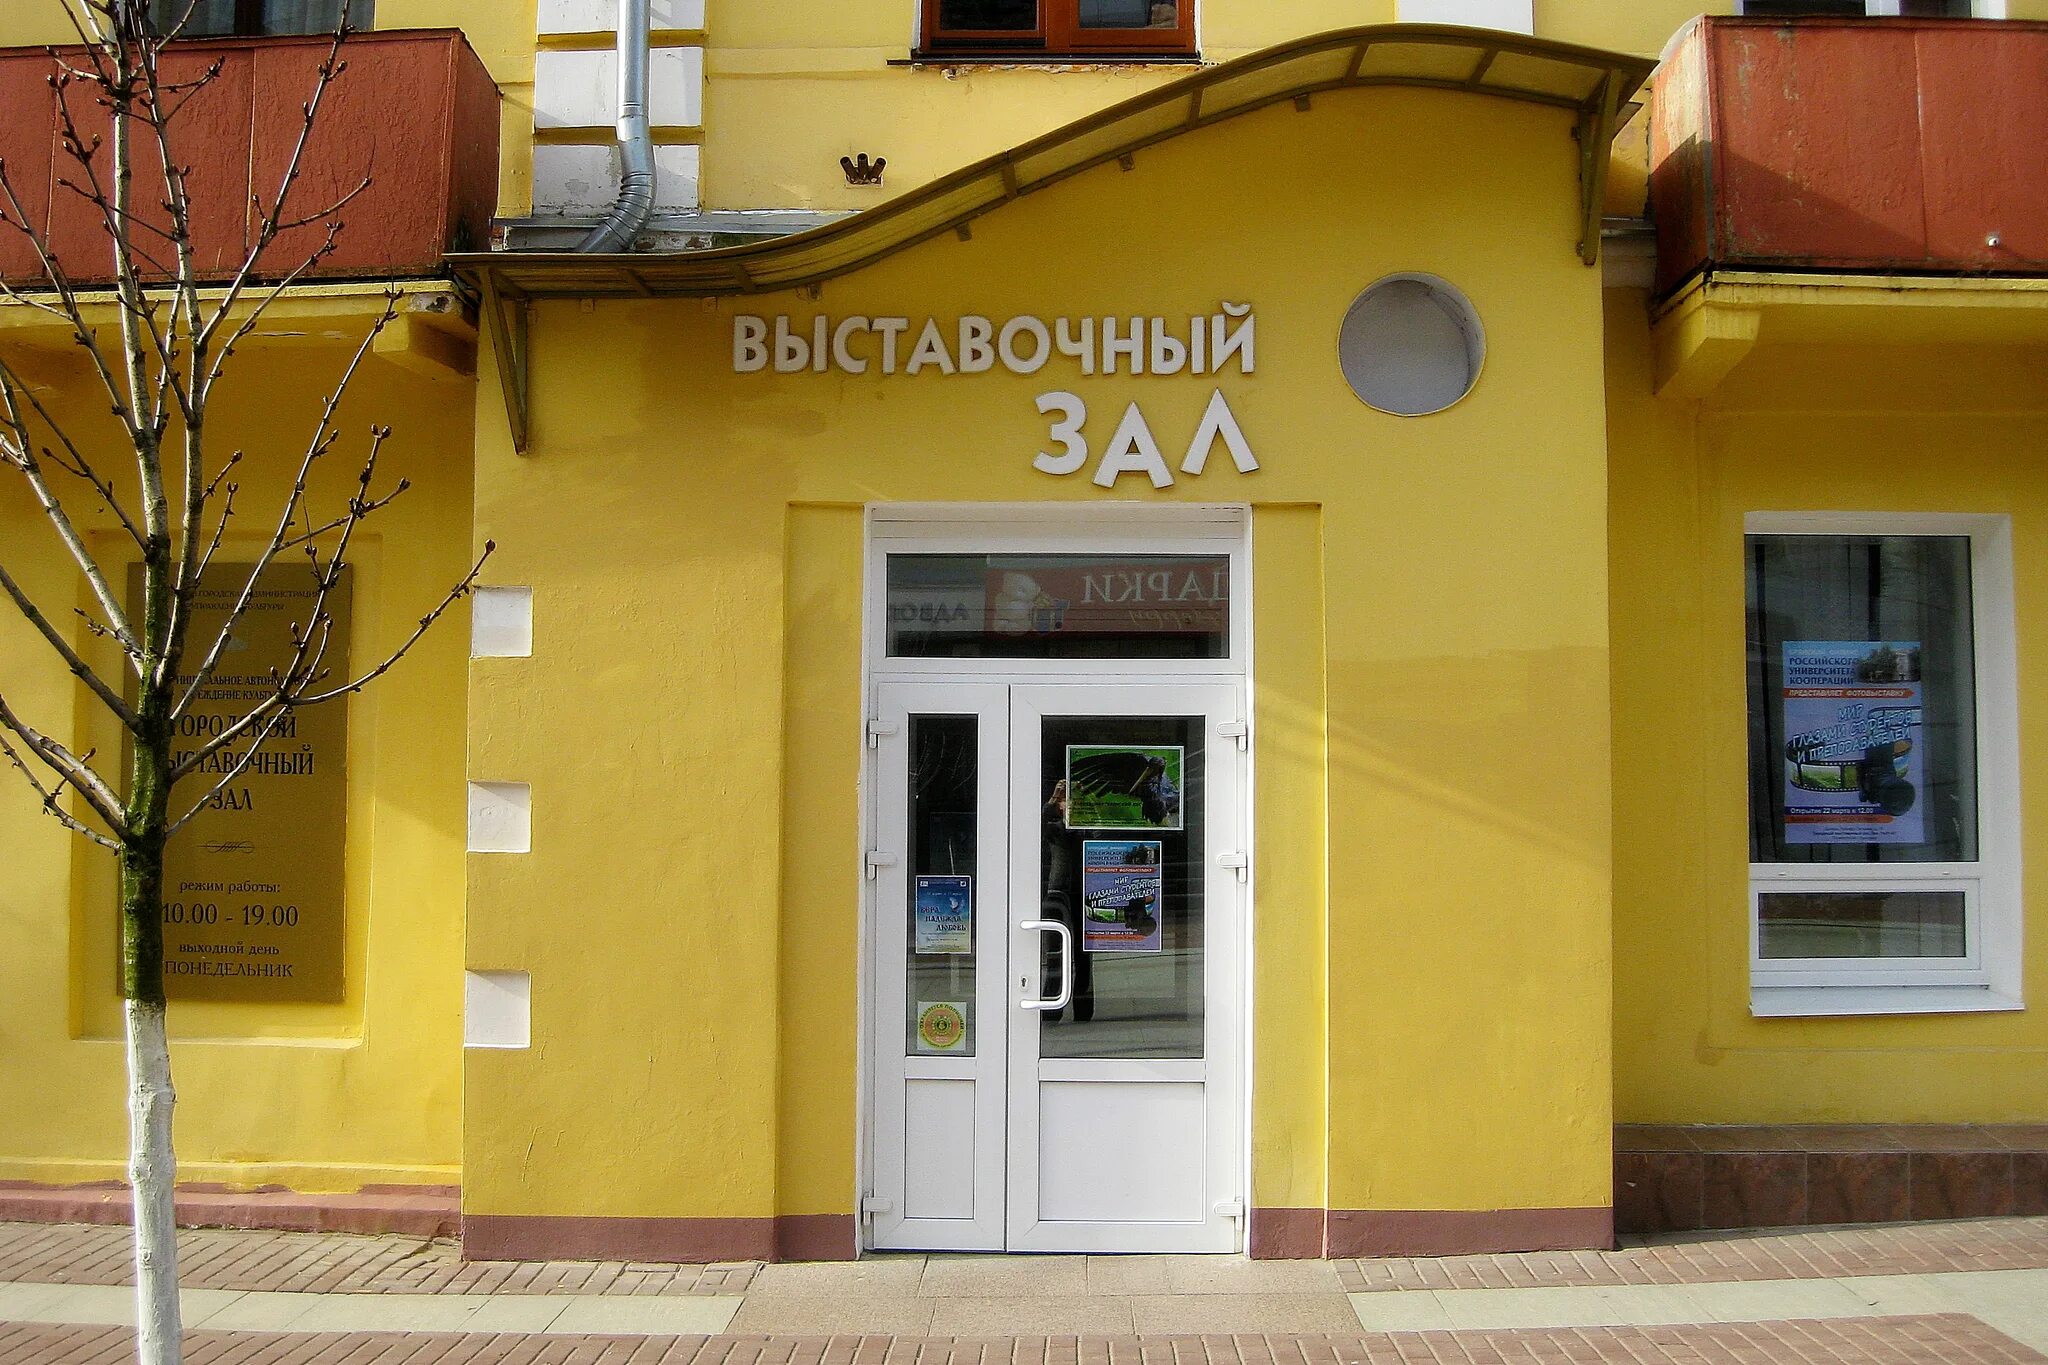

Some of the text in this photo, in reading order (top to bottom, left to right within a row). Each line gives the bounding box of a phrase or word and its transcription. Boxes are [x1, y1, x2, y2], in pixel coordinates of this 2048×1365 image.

[732, 301, 1256, 376] ВЫСТАВОЧНЫЙ
[1032, 388, 1260, 489] ЗАЛ
[1838, 703, 1864, 722] МИР
[210, 788, 252, 810] ЗАЛ
[179, 880, 281, 894] режим работы:
[162, 903, 218, 924] 10.00
[242, 904, 299, 926] 19.00
[179, 941, 280, 955] выходной день
[165, 961, 294, 977] ПОНЕДЕЛЬНИК
